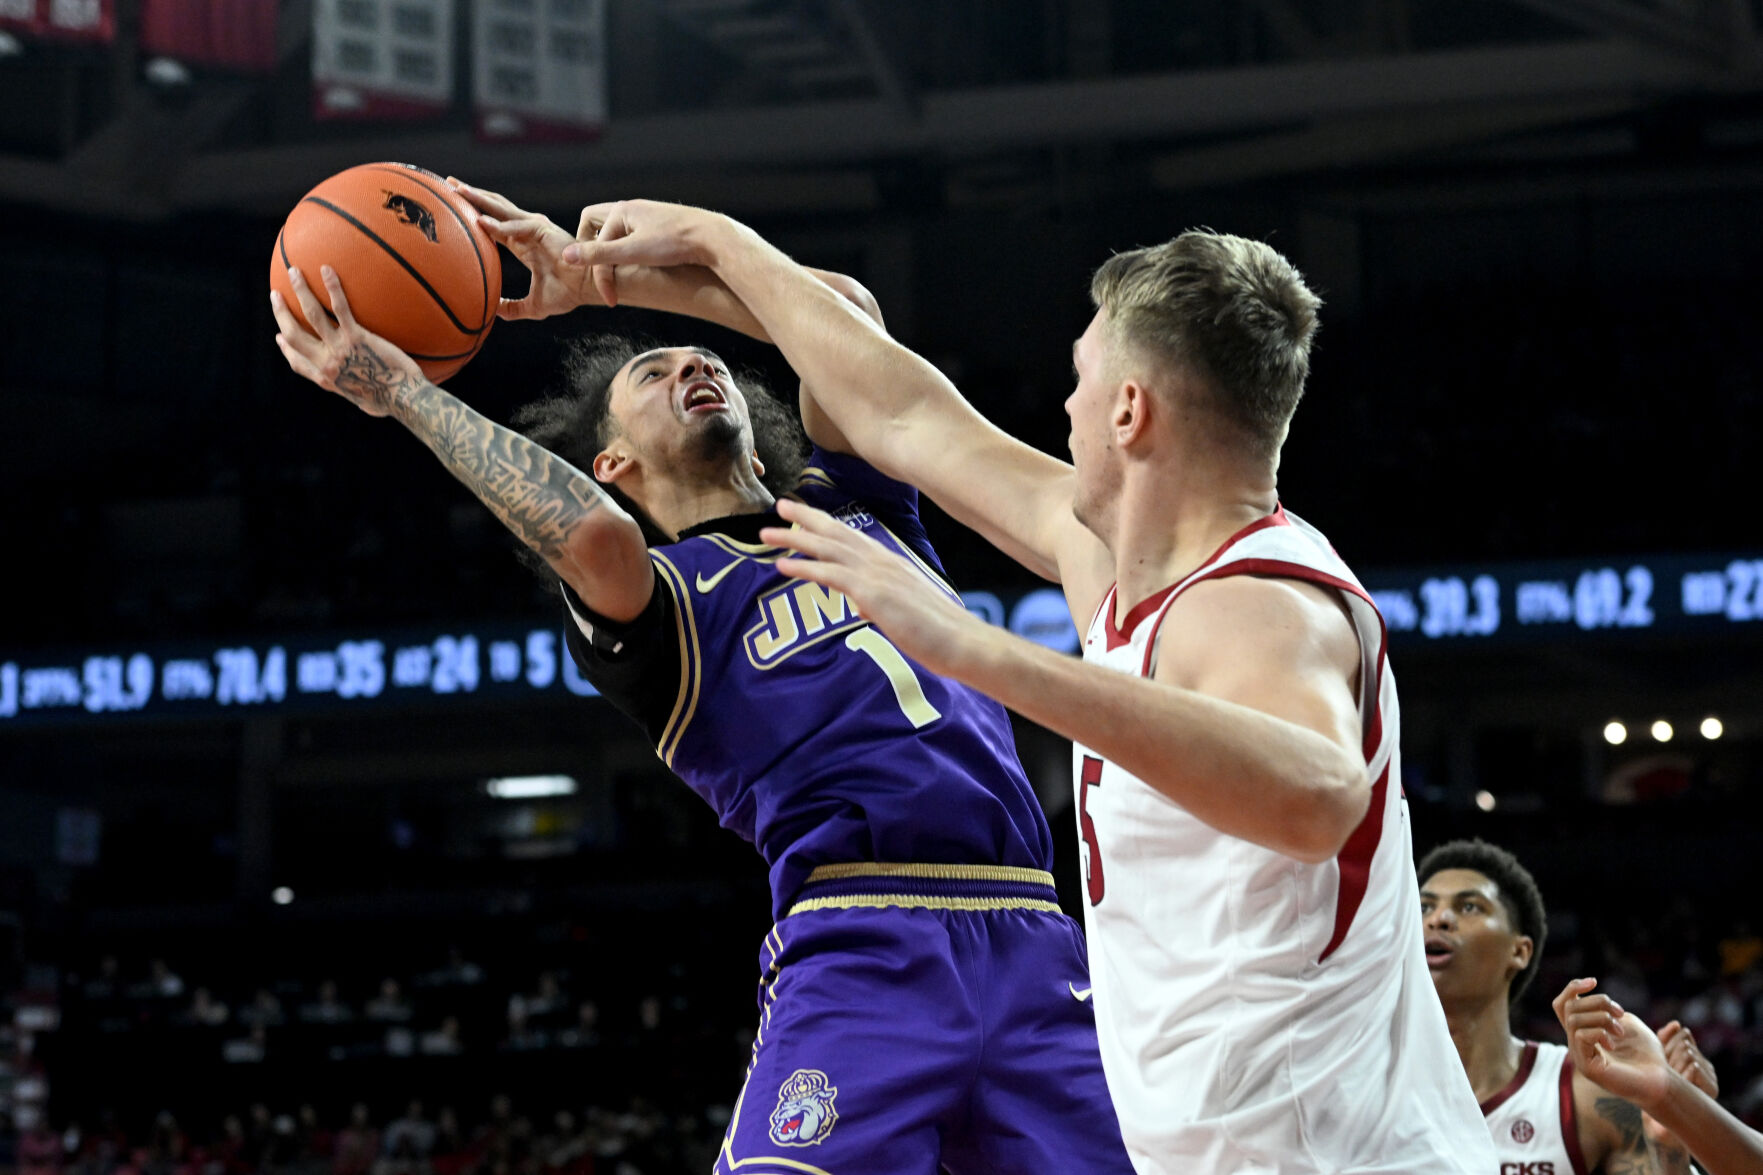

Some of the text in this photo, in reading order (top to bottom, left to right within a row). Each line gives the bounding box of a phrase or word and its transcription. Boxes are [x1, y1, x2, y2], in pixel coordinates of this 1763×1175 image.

[336, 639, 385, 698] 35
[431, 634, 478, 694] 24
[525, 629, 556, 688] 5
[754, 579, 861, 660] JM
[845, 625, 942, 729] 1
[1079, 754, 1105, 907] 5
